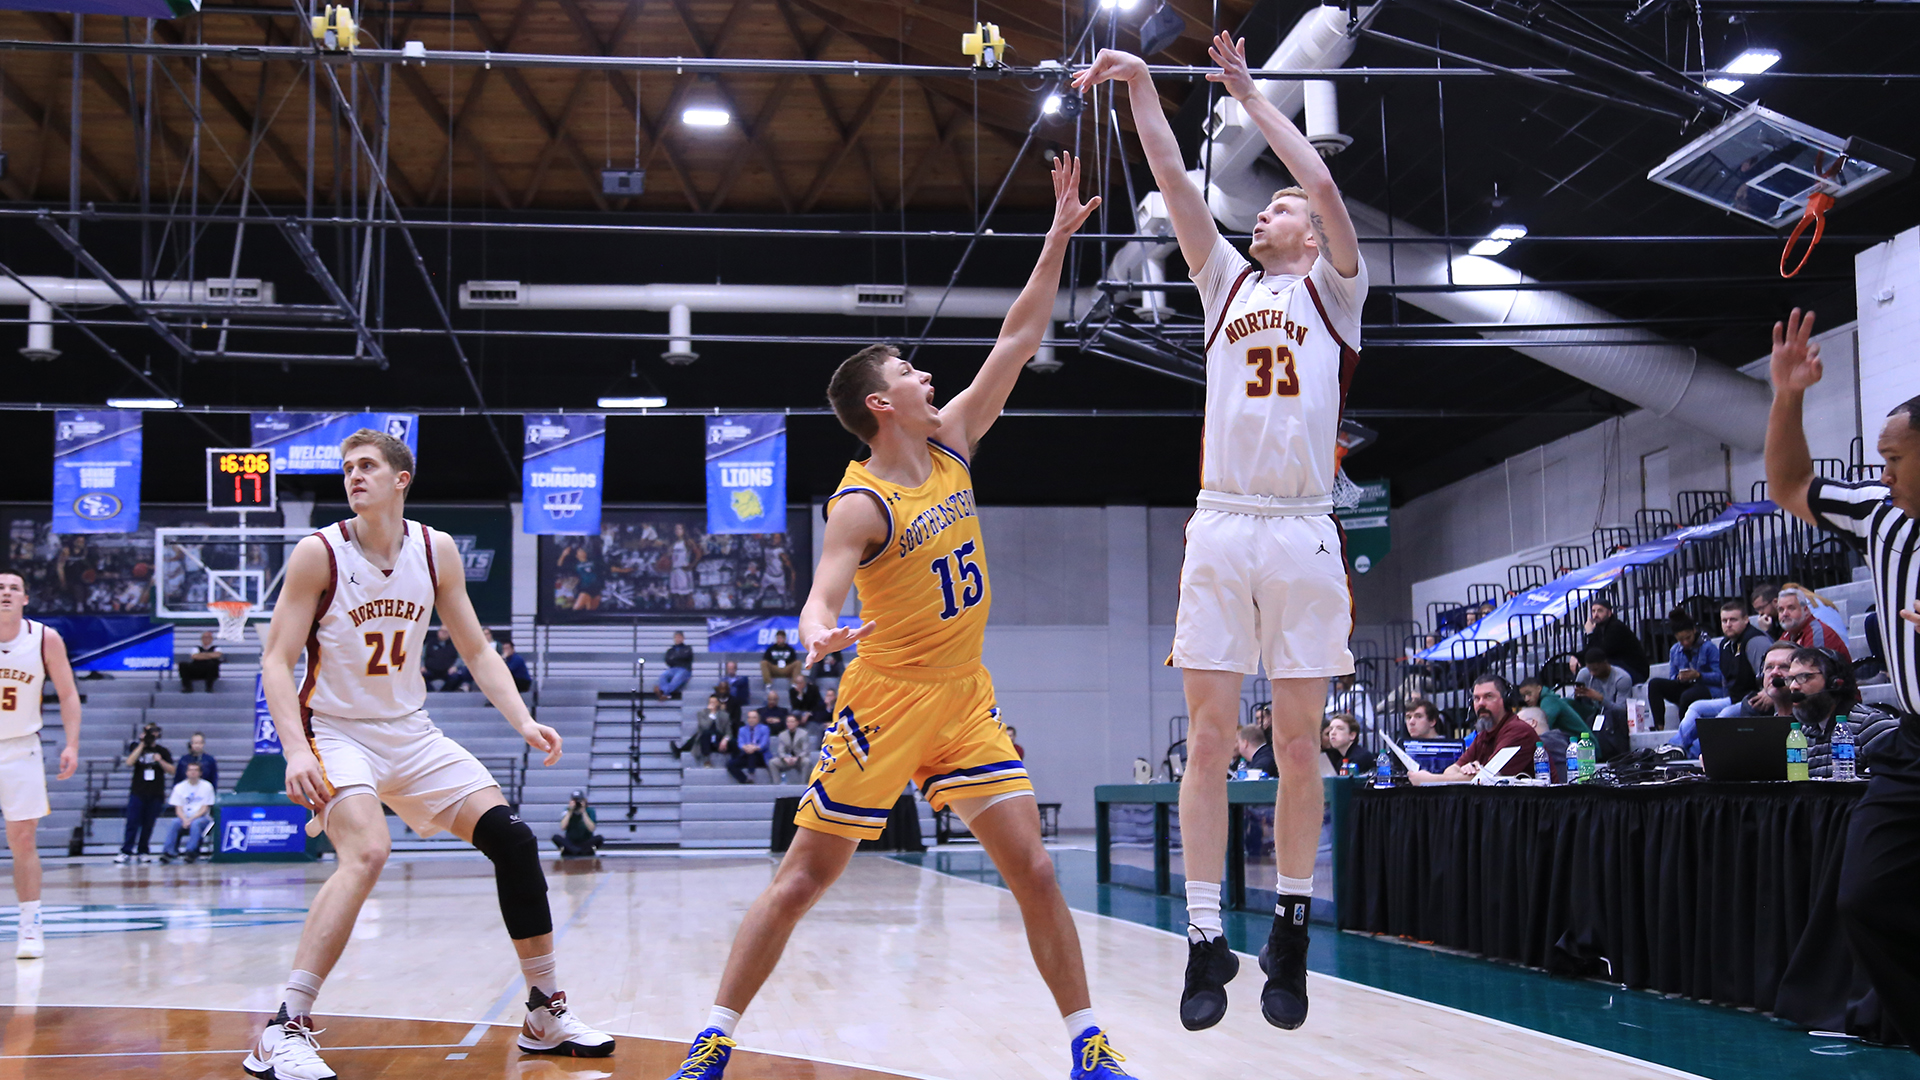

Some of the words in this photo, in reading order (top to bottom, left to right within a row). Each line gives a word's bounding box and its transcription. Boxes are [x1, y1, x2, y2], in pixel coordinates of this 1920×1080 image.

[1224, 309, 1309, 347] NORTHRN
[1245, 345, 1301, 398] 33
[220, 453, 270, 474] 16:06
[530, 472, 597, 488] ICHABODS
[721, 467, 774, 487] LIONS
[234, 472, 262, 503] 17
[931, 538, 984, 621] 15
[364, 629, 407, 676] 24
